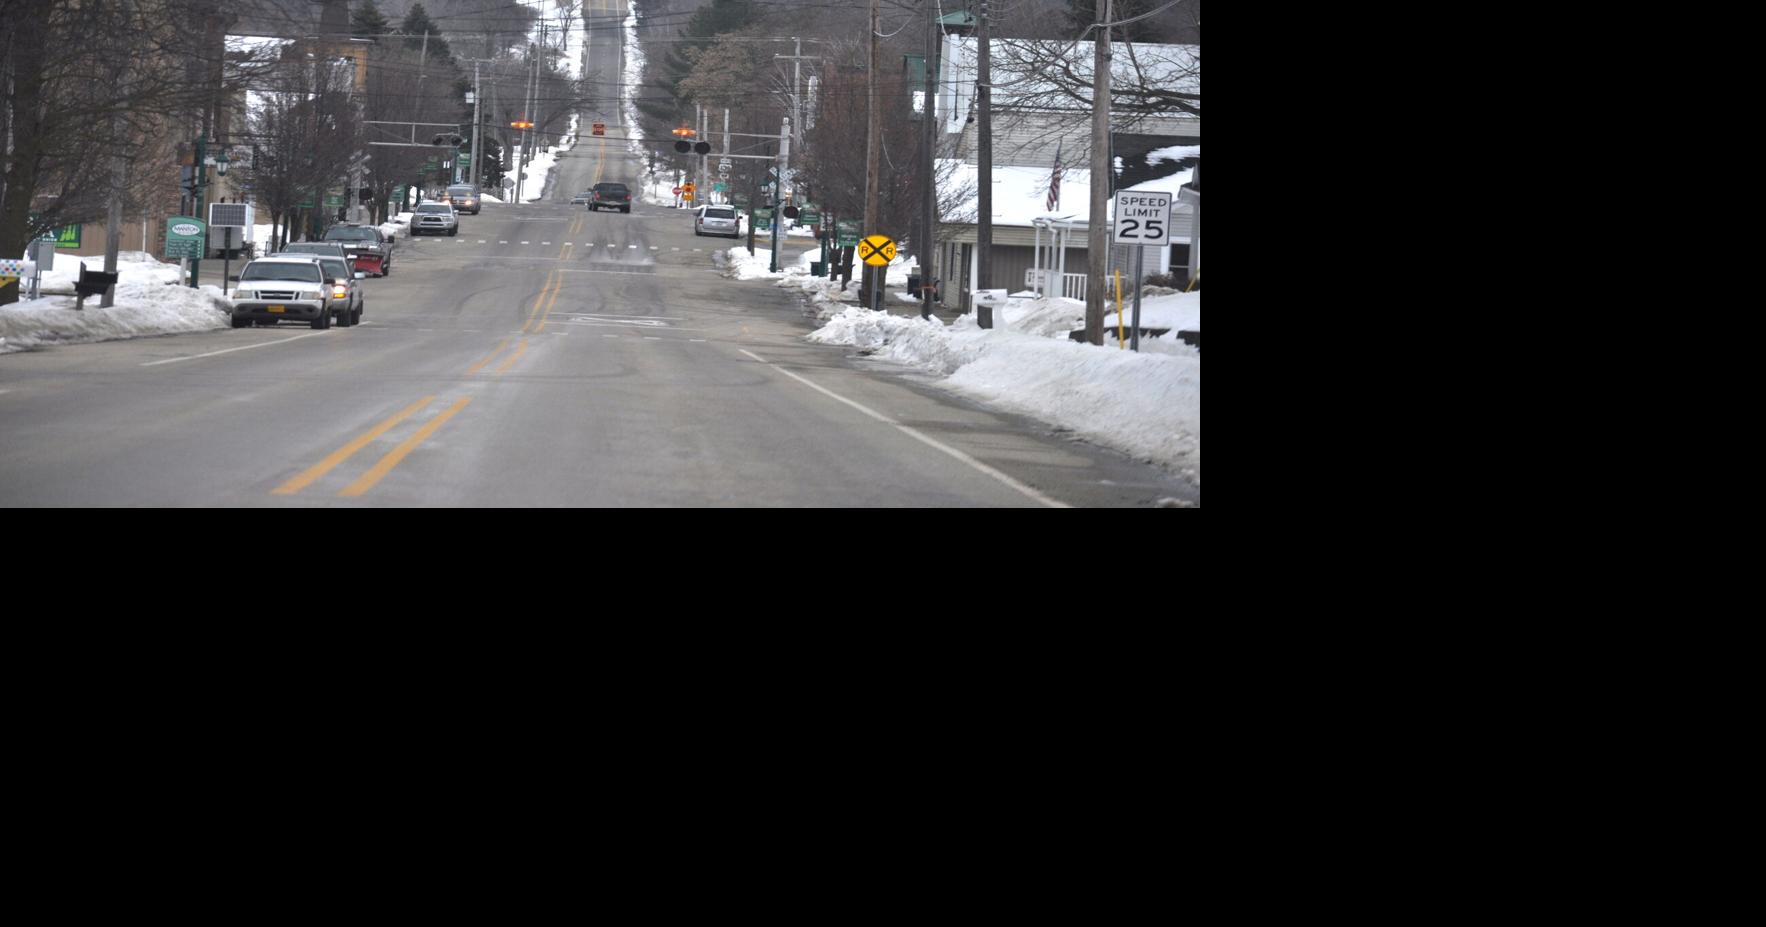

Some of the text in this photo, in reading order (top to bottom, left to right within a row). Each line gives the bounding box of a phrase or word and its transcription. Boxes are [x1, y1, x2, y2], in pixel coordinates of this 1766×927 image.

[1120, 196, 1167, 207] SPEED
[1124, 208, 1161, 217] LIMIT
[1119, 218, 1163, 239] 25
[861, 246, 894, 255] R R
